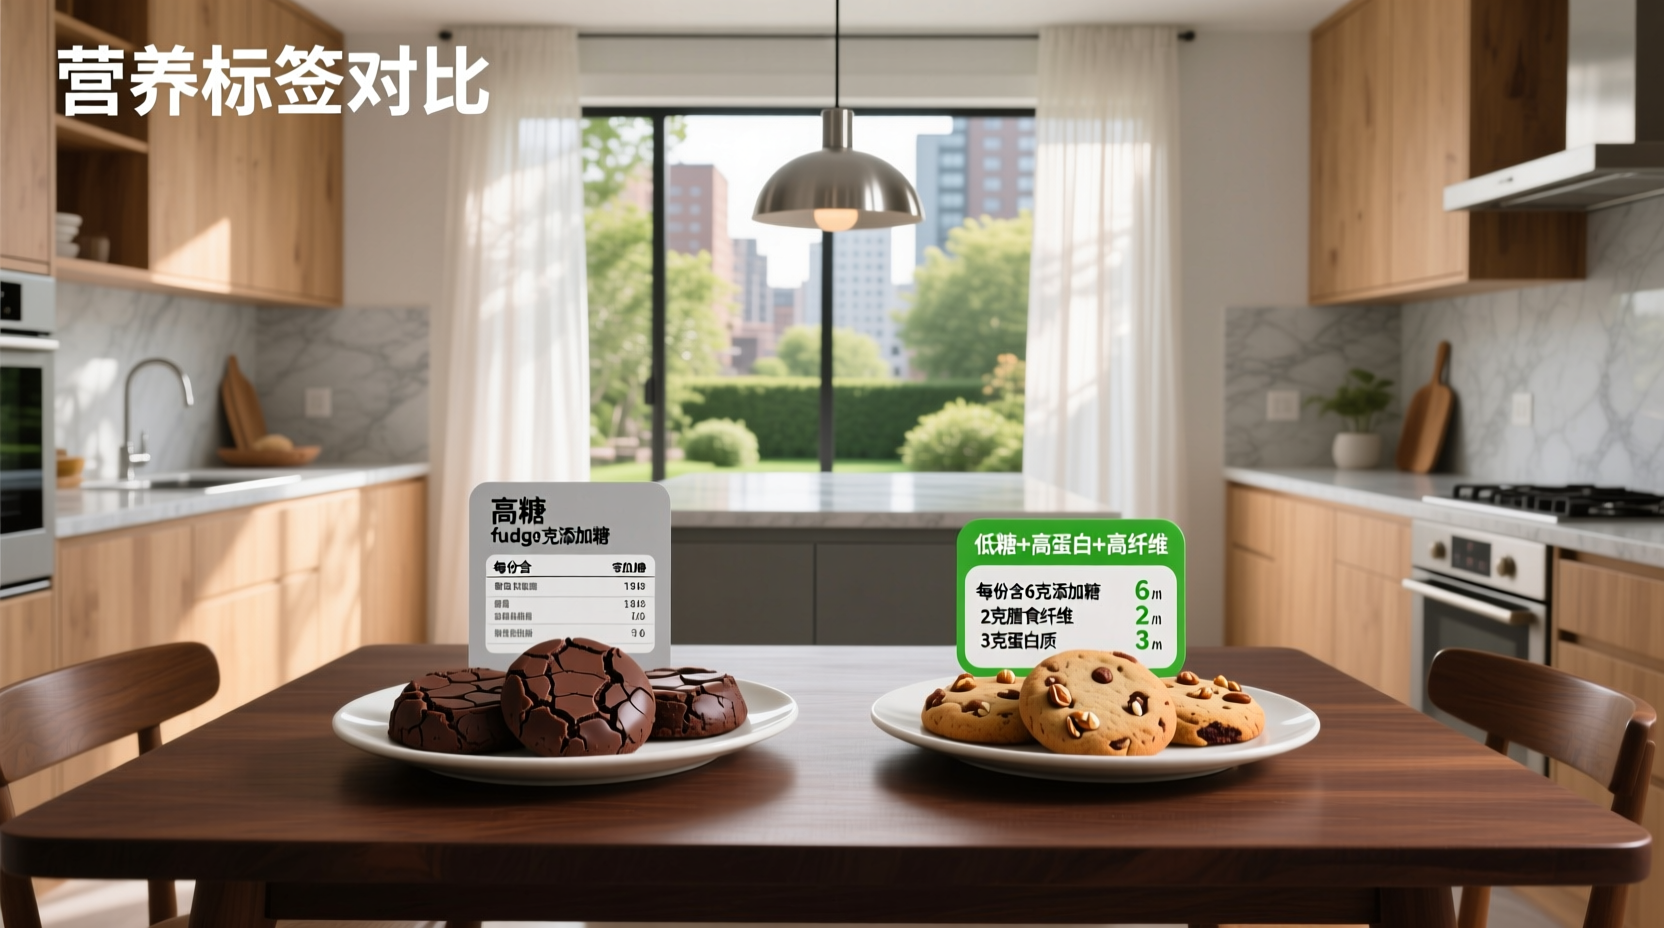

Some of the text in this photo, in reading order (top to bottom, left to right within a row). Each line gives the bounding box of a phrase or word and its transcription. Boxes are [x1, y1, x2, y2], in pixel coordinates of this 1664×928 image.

[491, 496, 546, 525] 高糖
[975, 532, 1169, 556] 低糖+高蛋白+高纤维
[976, 581, 1101, 601] 每份含6克添加糖
[981, 631, 1057, 650] 3克蛋白质
